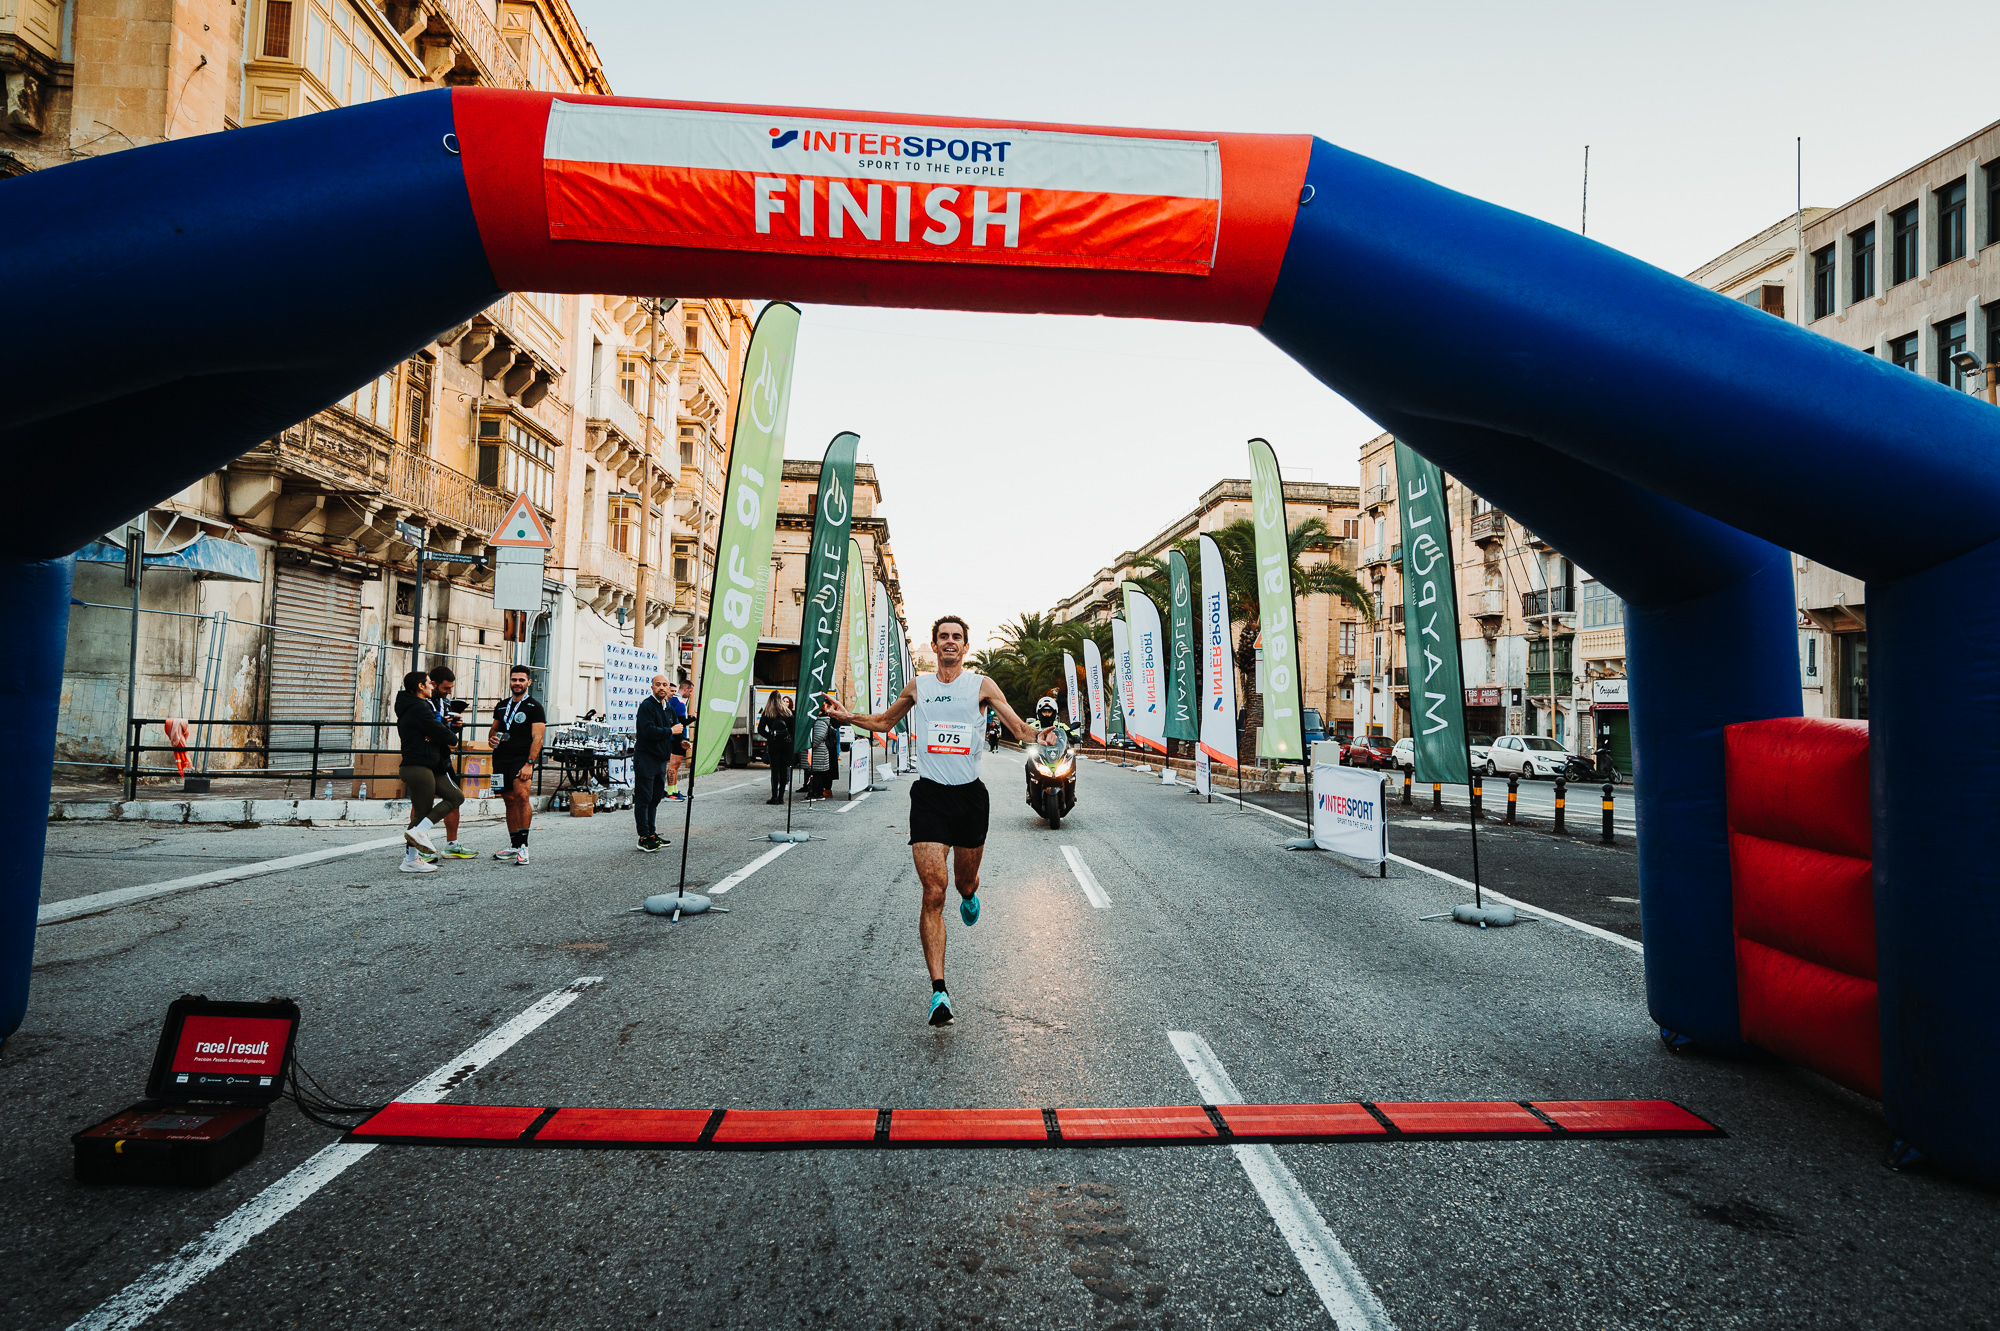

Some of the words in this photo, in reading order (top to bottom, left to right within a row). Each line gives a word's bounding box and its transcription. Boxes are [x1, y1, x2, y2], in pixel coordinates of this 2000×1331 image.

[803, 129, 1012, 163] INTERSPORT
[858, 159, 900, 171] SPORT
[905, 161, 921, 171] TO
[926, 162, 951, 173] THE
[956, 166, 1006, 177] PEOPLE
[754, 176, 1022, 248] FINISH
[836, 588, 844, 608] since
[807, 543, 842, 721] MAYPOLE
[833, 609, 842, 633] bakers
[1600, 685, 1621, 698] Original
[938, 733, 960, 744] 075
[1325, 793, 1374, 821] INTERSPORT
